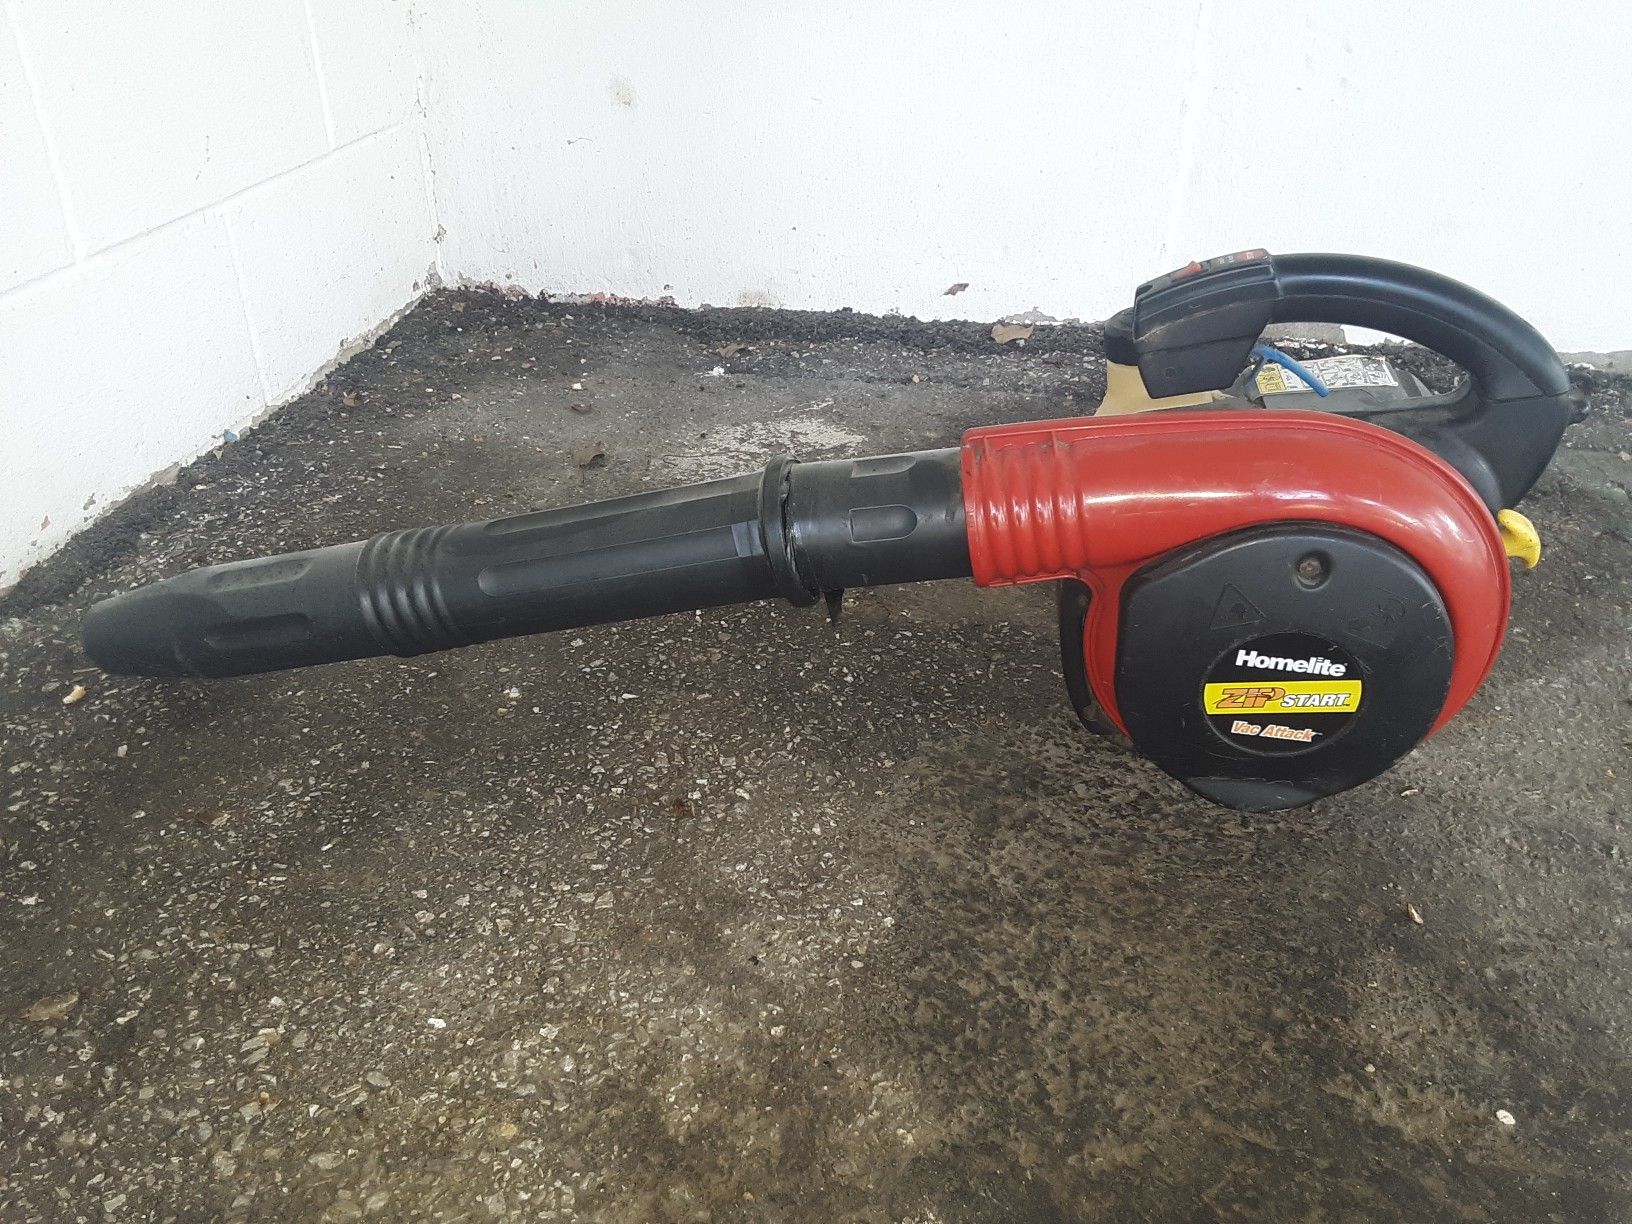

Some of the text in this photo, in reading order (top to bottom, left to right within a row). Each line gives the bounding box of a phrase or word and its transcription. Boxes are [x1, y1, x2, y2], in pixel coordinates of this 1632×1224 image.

[1235, 649, 1347, 677] Homelite
[1281, 693, 1351, 708] START
[1231, 720, 1314, 742] Vac Attack
